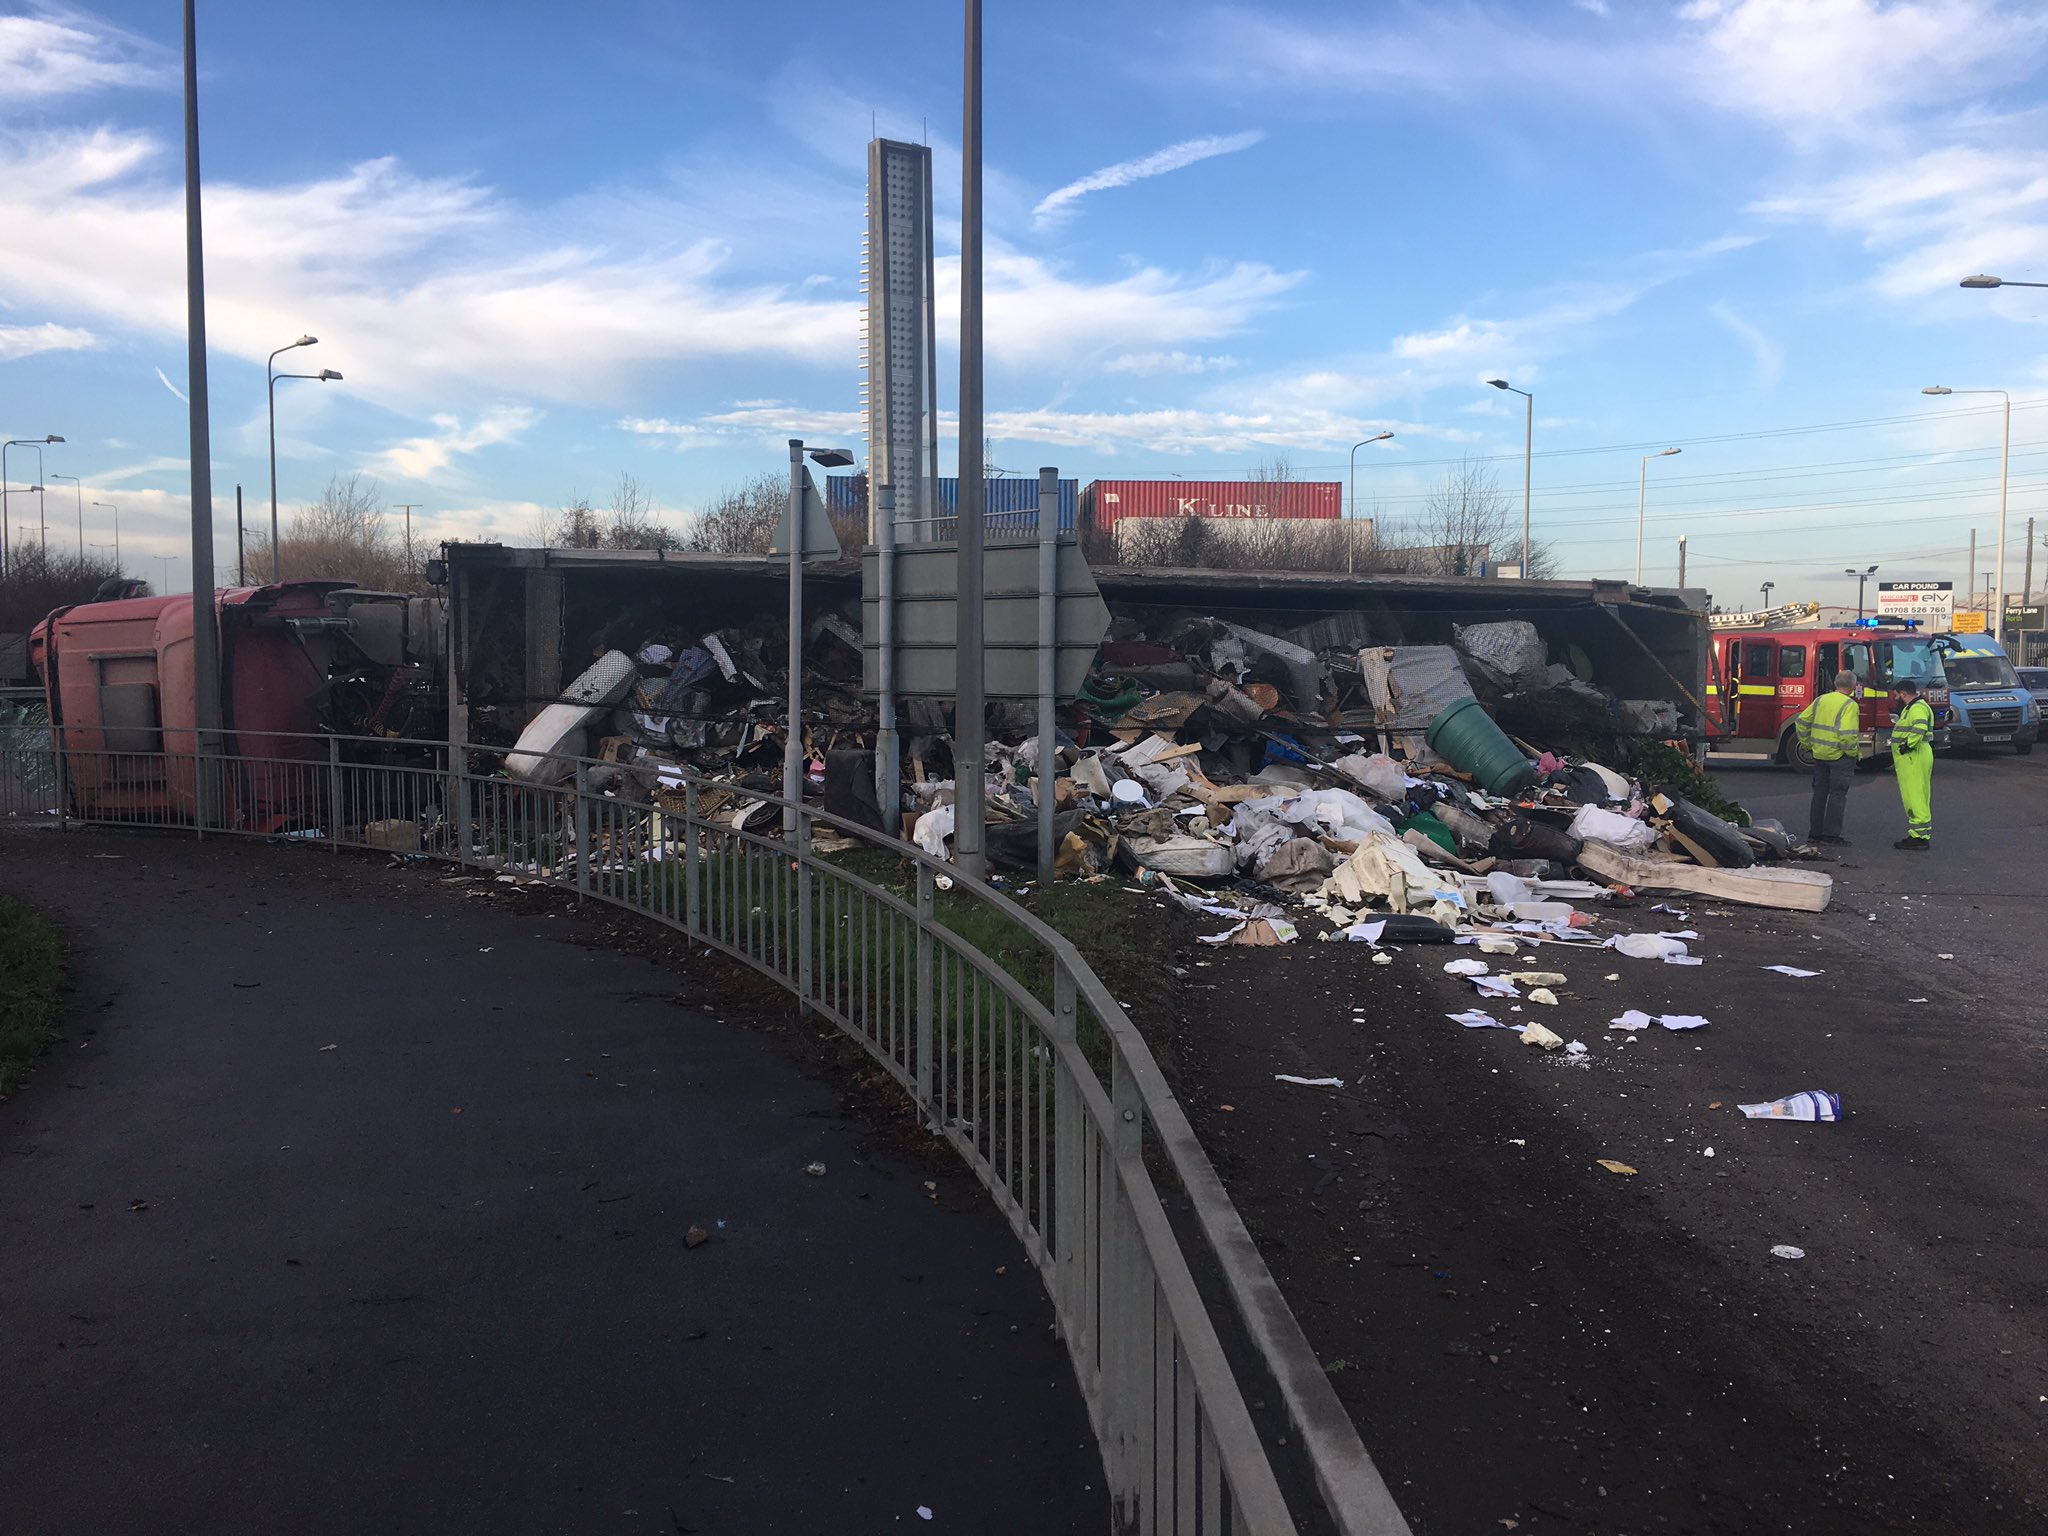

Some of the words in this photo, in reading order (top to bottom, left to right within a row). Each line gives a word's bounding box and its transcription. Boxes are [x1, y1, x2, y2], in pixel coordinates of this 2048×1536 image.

[1209, 504, 1268, 517] LINE
[1921, 592, 1949, 602] elv
[2005, 607, 2022, 615] Ferry
[1779, 685, 1805, 695] LFB
[1928, 690, 1948, 702] FIRE
